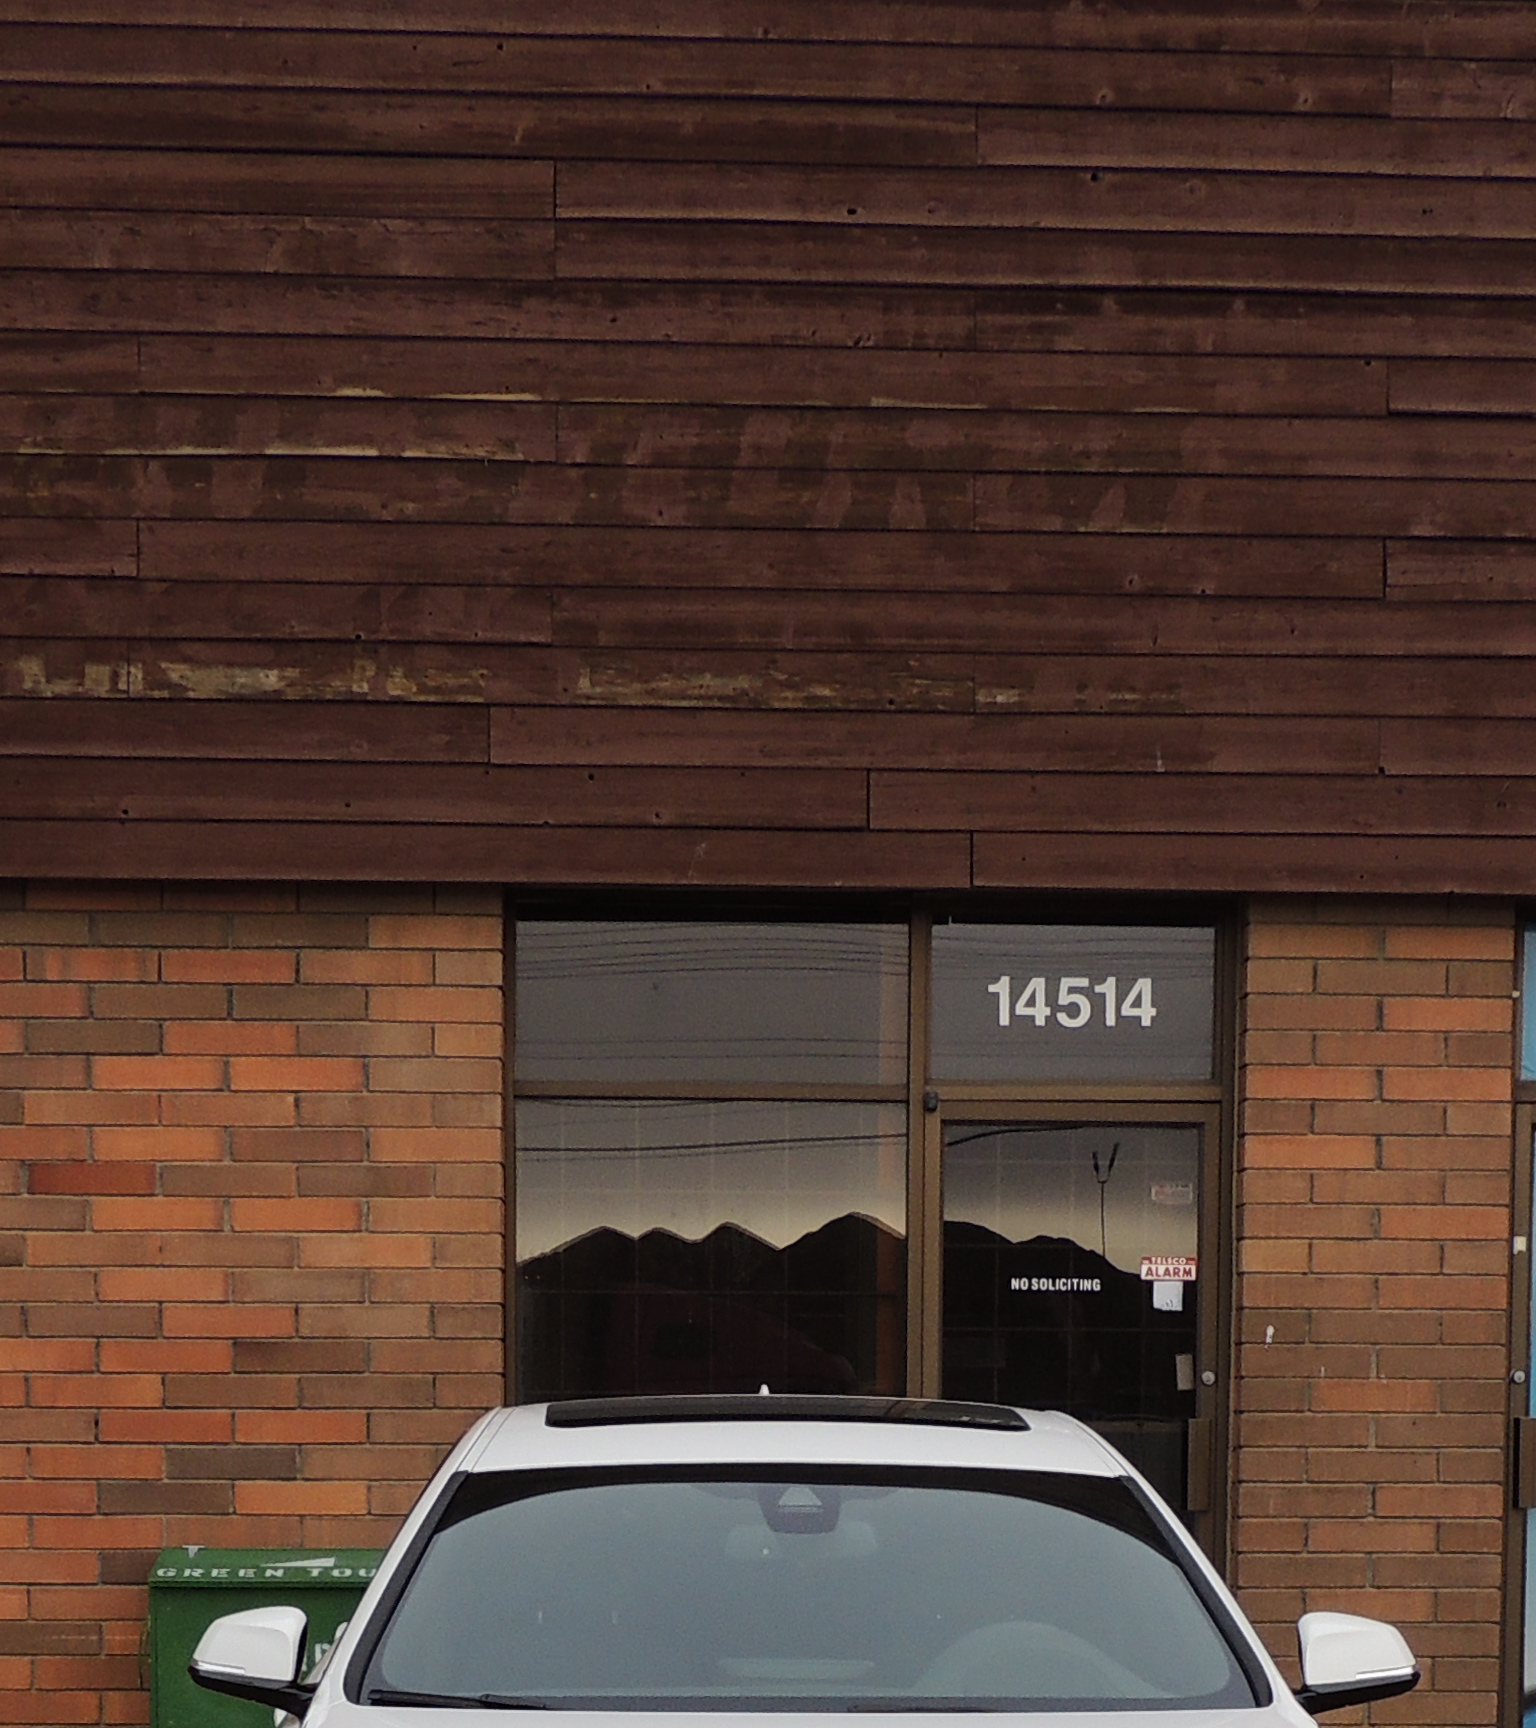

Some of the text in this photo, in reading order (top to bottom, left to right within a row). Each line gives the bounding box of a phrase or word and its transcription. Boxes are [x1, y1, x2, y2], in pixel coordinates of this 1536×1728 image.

[987, 975, 1157, 1028] 14514
[1144, 1266, 1193, 1278] ALARM
[1011, 1277, 1101, 1292] NO SOLICITING
[156, 1568, 285, 1578] GREEN
